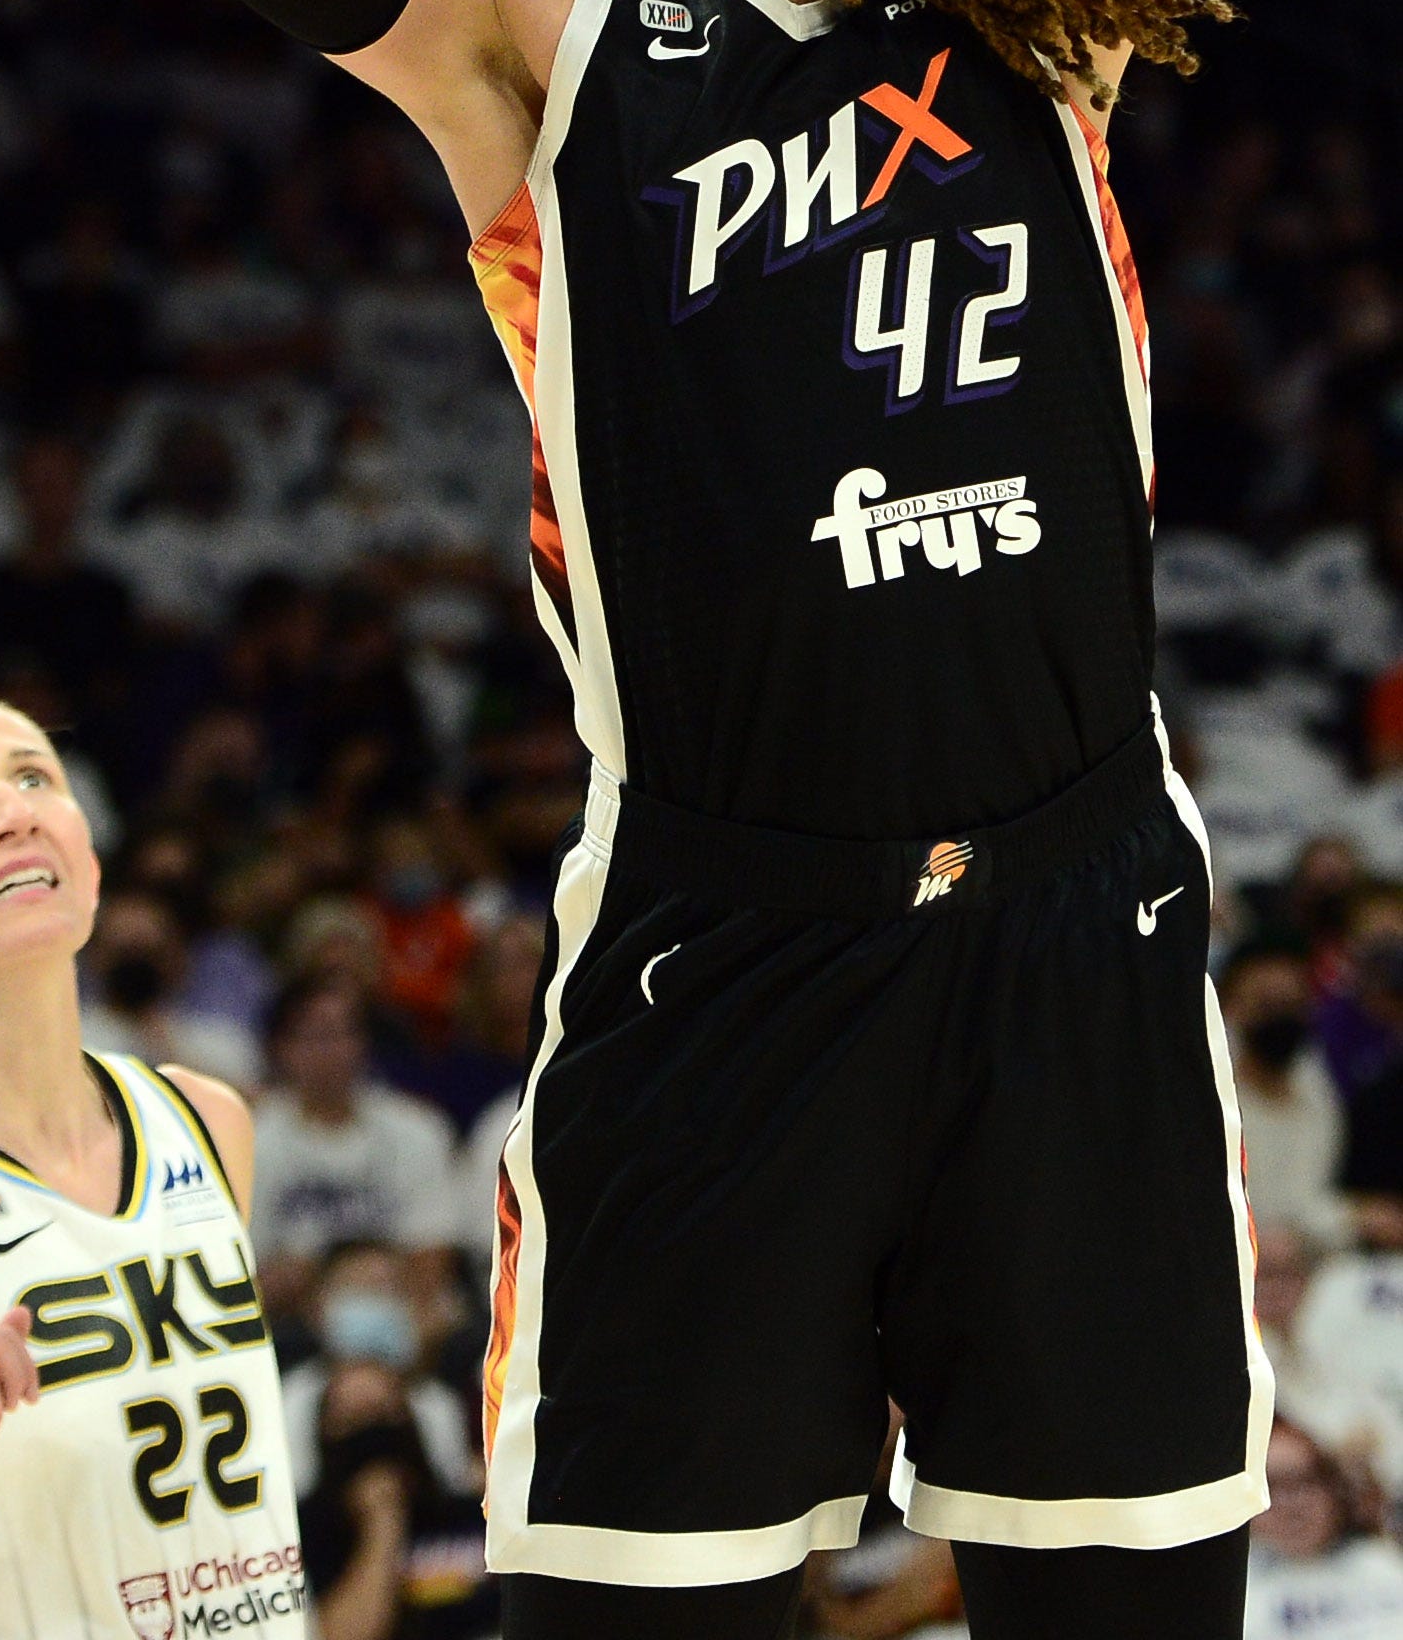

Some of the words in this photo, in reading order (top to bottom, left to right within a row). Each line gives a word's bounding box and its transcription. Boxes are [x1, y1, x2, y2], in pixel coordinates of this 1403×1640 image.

[672, 47, 973, 296] PHX
[855, 223, 1029, 397] 42
[868, 498, 926, 525] FOOD
[936, 481, 1020, 510] STORES
[16, 1242, 270, 1393] SKY
[123, 1384, 264, 1530] 22
